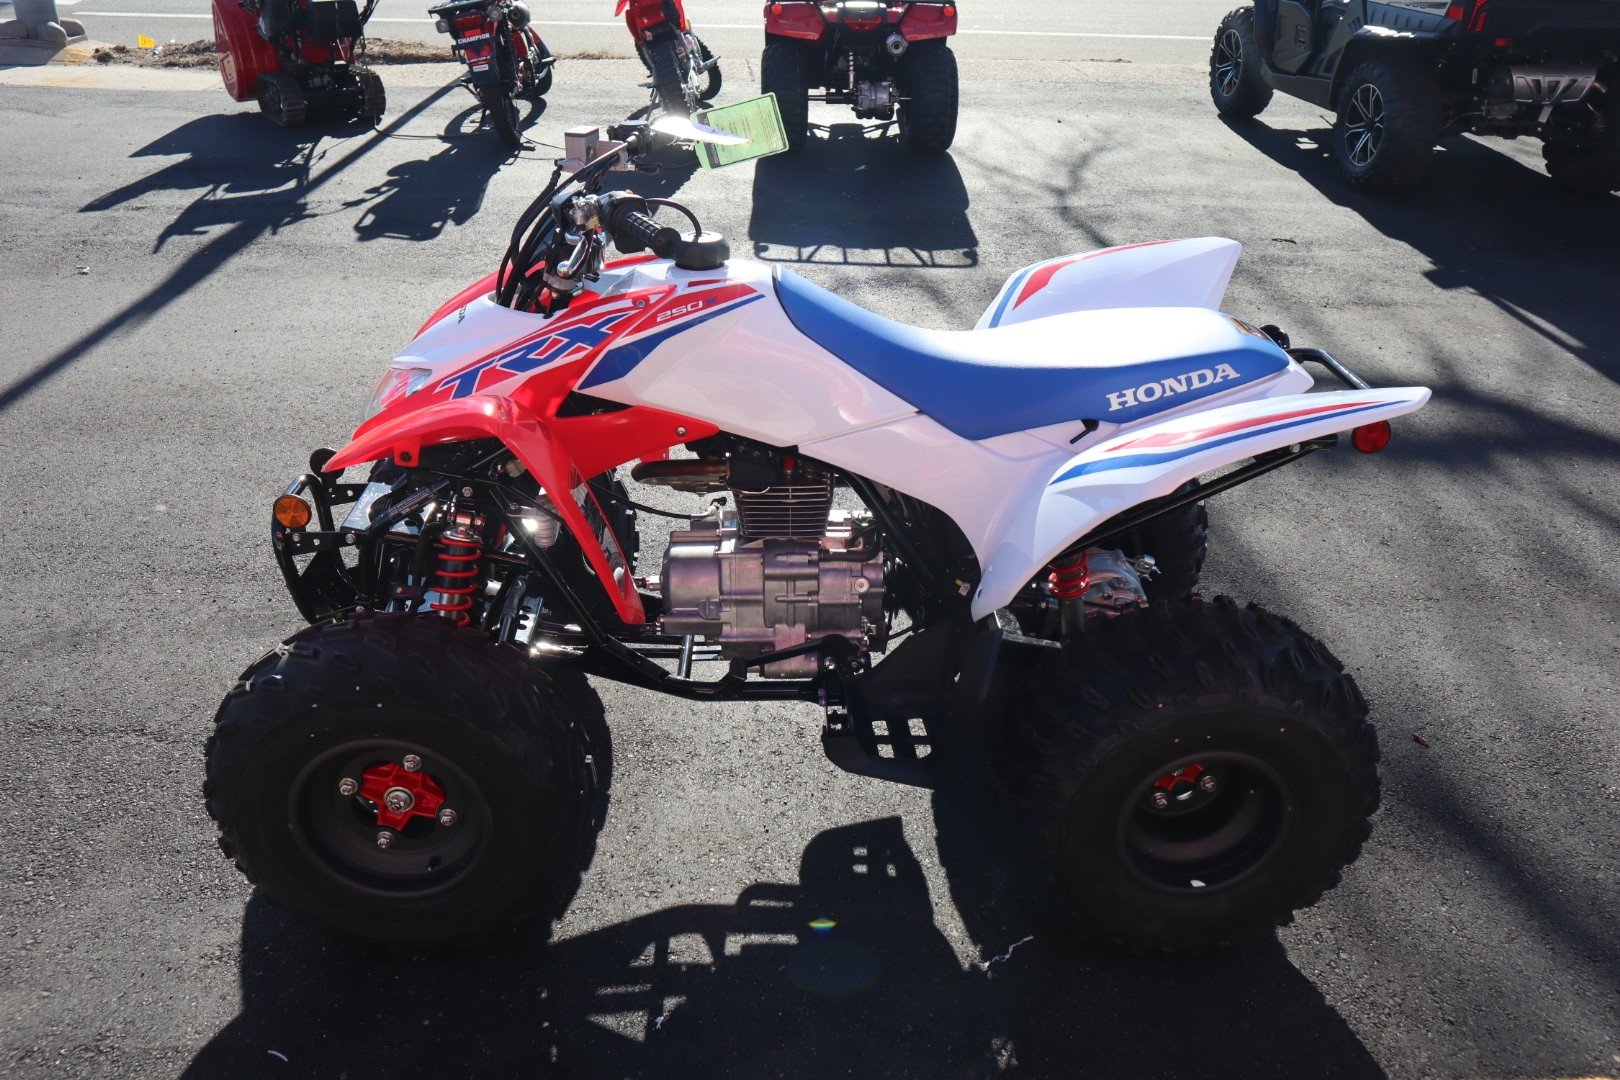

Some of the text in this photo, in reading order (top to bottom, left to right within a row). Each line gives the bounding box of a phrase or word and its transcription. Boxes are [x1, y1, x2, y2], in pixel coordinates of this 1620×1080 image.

[457, 32, 490, 45] CHAMPION
[434, 309, 640, 400] TRX
[1106, 363, 1241, 411] HONDA
